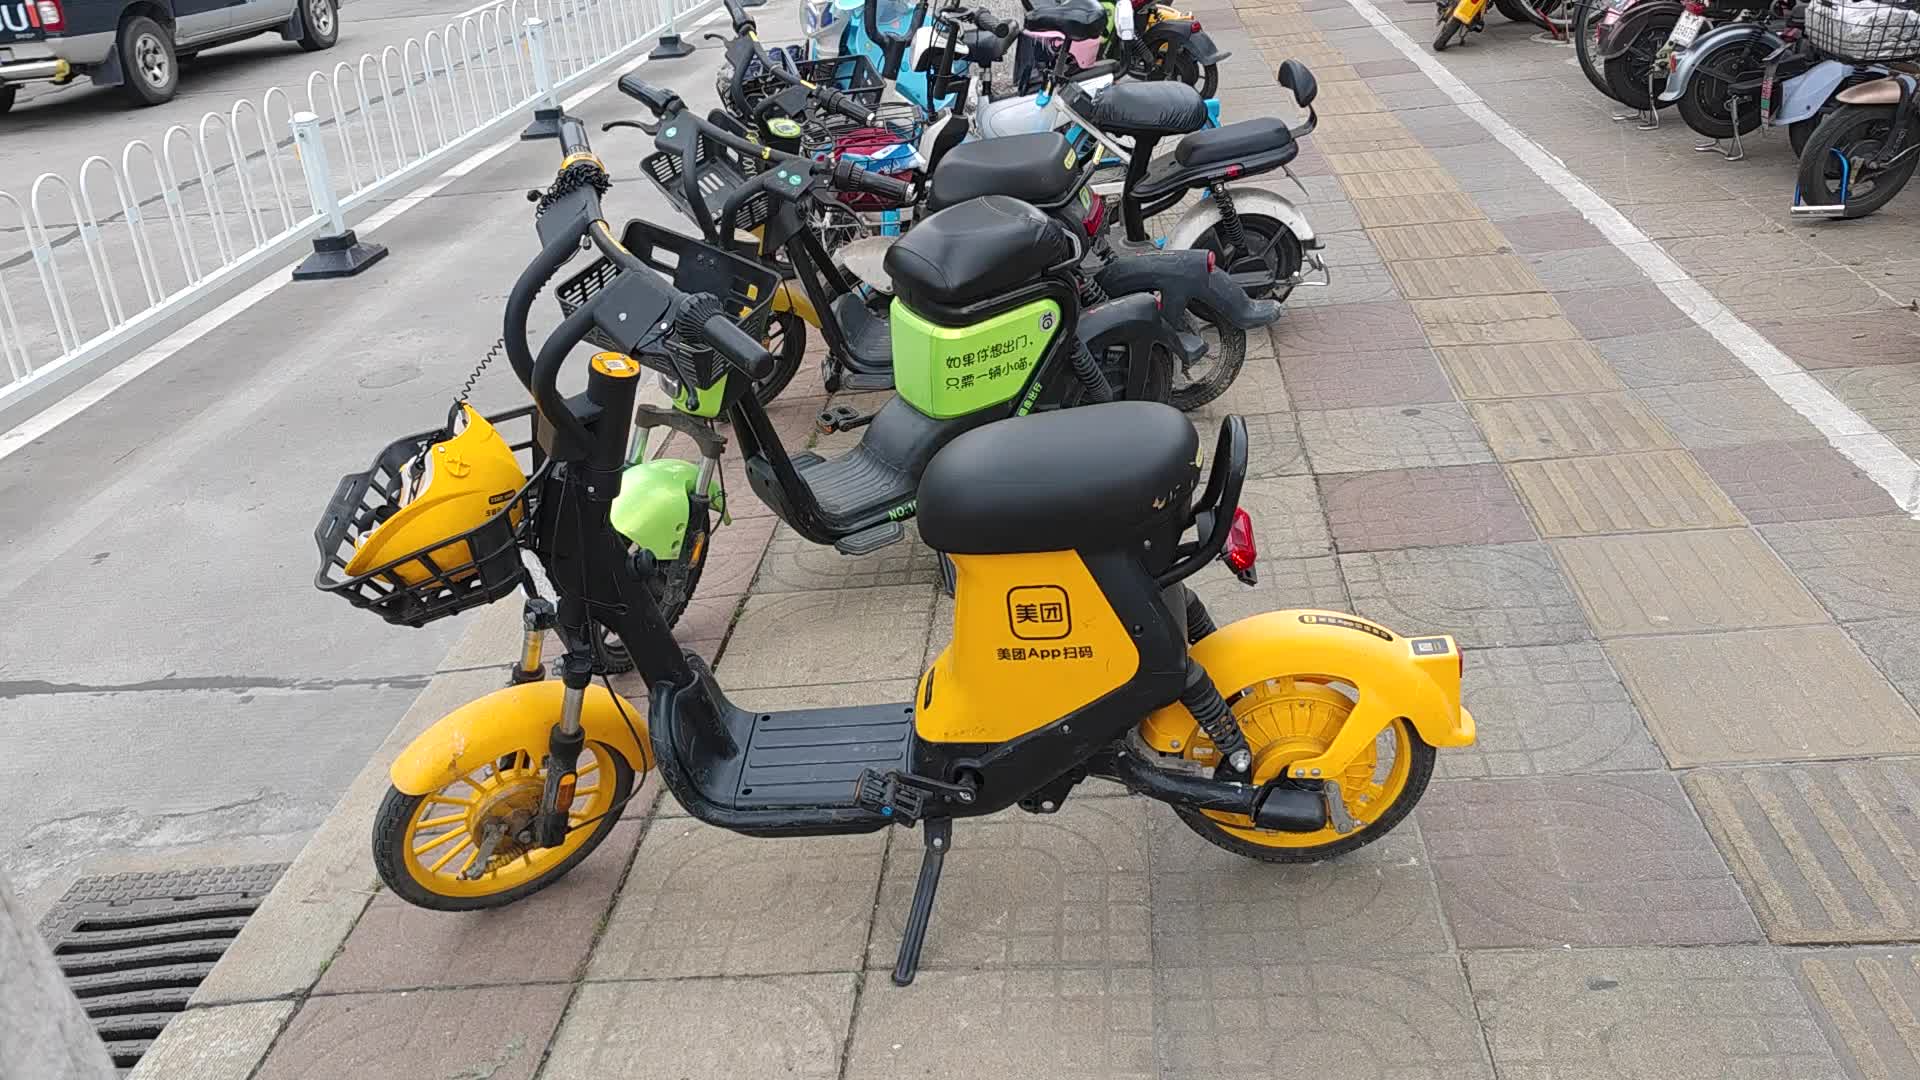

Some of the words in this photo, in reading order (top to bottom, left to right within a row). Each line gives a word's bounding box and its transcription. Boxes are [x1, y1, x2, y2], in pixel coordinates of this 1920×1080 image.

[1015, 602, 1063, 624] 美团
[997, 645, 1093, 661] 美团App扫码
